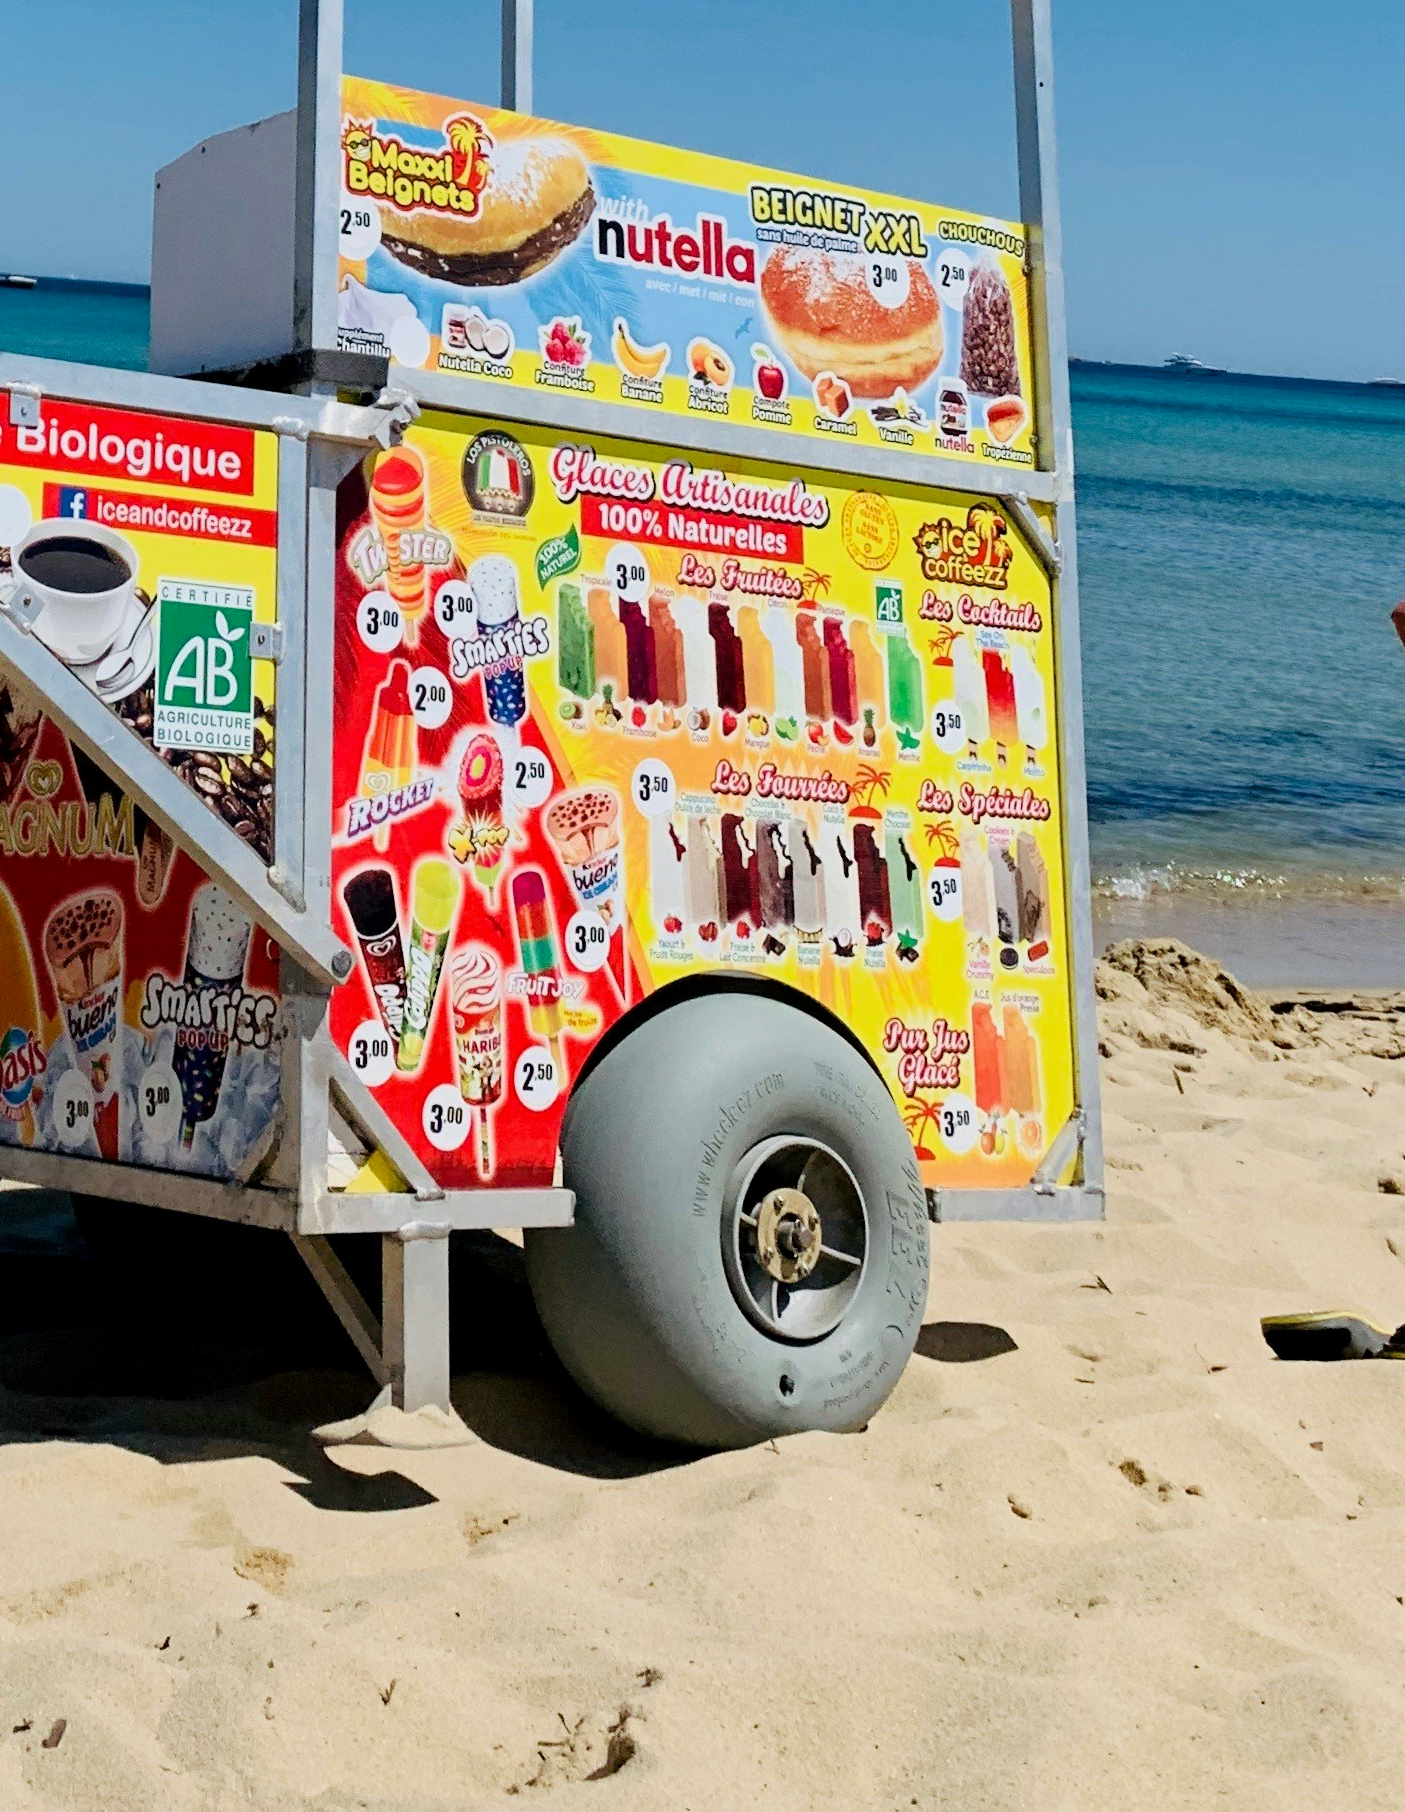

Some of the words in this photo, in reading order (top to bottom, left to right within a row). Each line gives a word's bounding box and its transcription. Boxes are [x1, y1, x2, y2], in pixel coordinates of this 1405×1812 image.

[372, 138, 453, 183] Maxxi
[348, 159, 476, 214] Beignets
[750, 187, 865, 236] BEIGNET
[863, 211, 928, 258] XXL
[938, 220, 1025, 256] CHOUCHOUS
[598, 216, 756, 285] nutella
[437, 354, 482, 374] Nutella
[483, 360, 514, 379] Coco
[534, 370, 595, 392] Framboise
[620, 384, 664, 404] Banane
[687, 394, 730, 415] Abricot
[751, 406, 793, 426] Pomme
[813, 417, 858, 436] Caramel
[878, 428, 914, 446] Vanille
[15, 413, 242, 483] Biologique
[935, 437, 975, 454] nutella
[551, 446, 656, 503] Glaces
[660, 460, 830, 524] Artisanales
[96, 493, 253, 539] iceandcoffeezz
[599, 502, 663, 539] 100%
[668, 514, 788, 556] Naturelles
[678, 554, 716, 587] Les
[721, 558, 804, 599] Fruitées
[918, 589, 954, 621] Les
[957, 594, 1043, 632] Cocktails
[165, 634, 239, 706] AB
[156, 709, 253, 731] AGRICULTURE
[156, 728, 253, 749] BIOLOGIQUE
[711, 759, 751, 797] Les
[755, 763, 850, 803] Fourrées
[917, 778, 954, 815] Les
[958, 780, 1052, 825] Spéciales
[347, 778, 434, 839] ROCKET
[507, 972, 554, 996] FRUIT
[883, 1017, 930, 1054] Pur
[931, 1017, 970, 1056] Jus
[898, 1048, 961, 1098] Glacé
